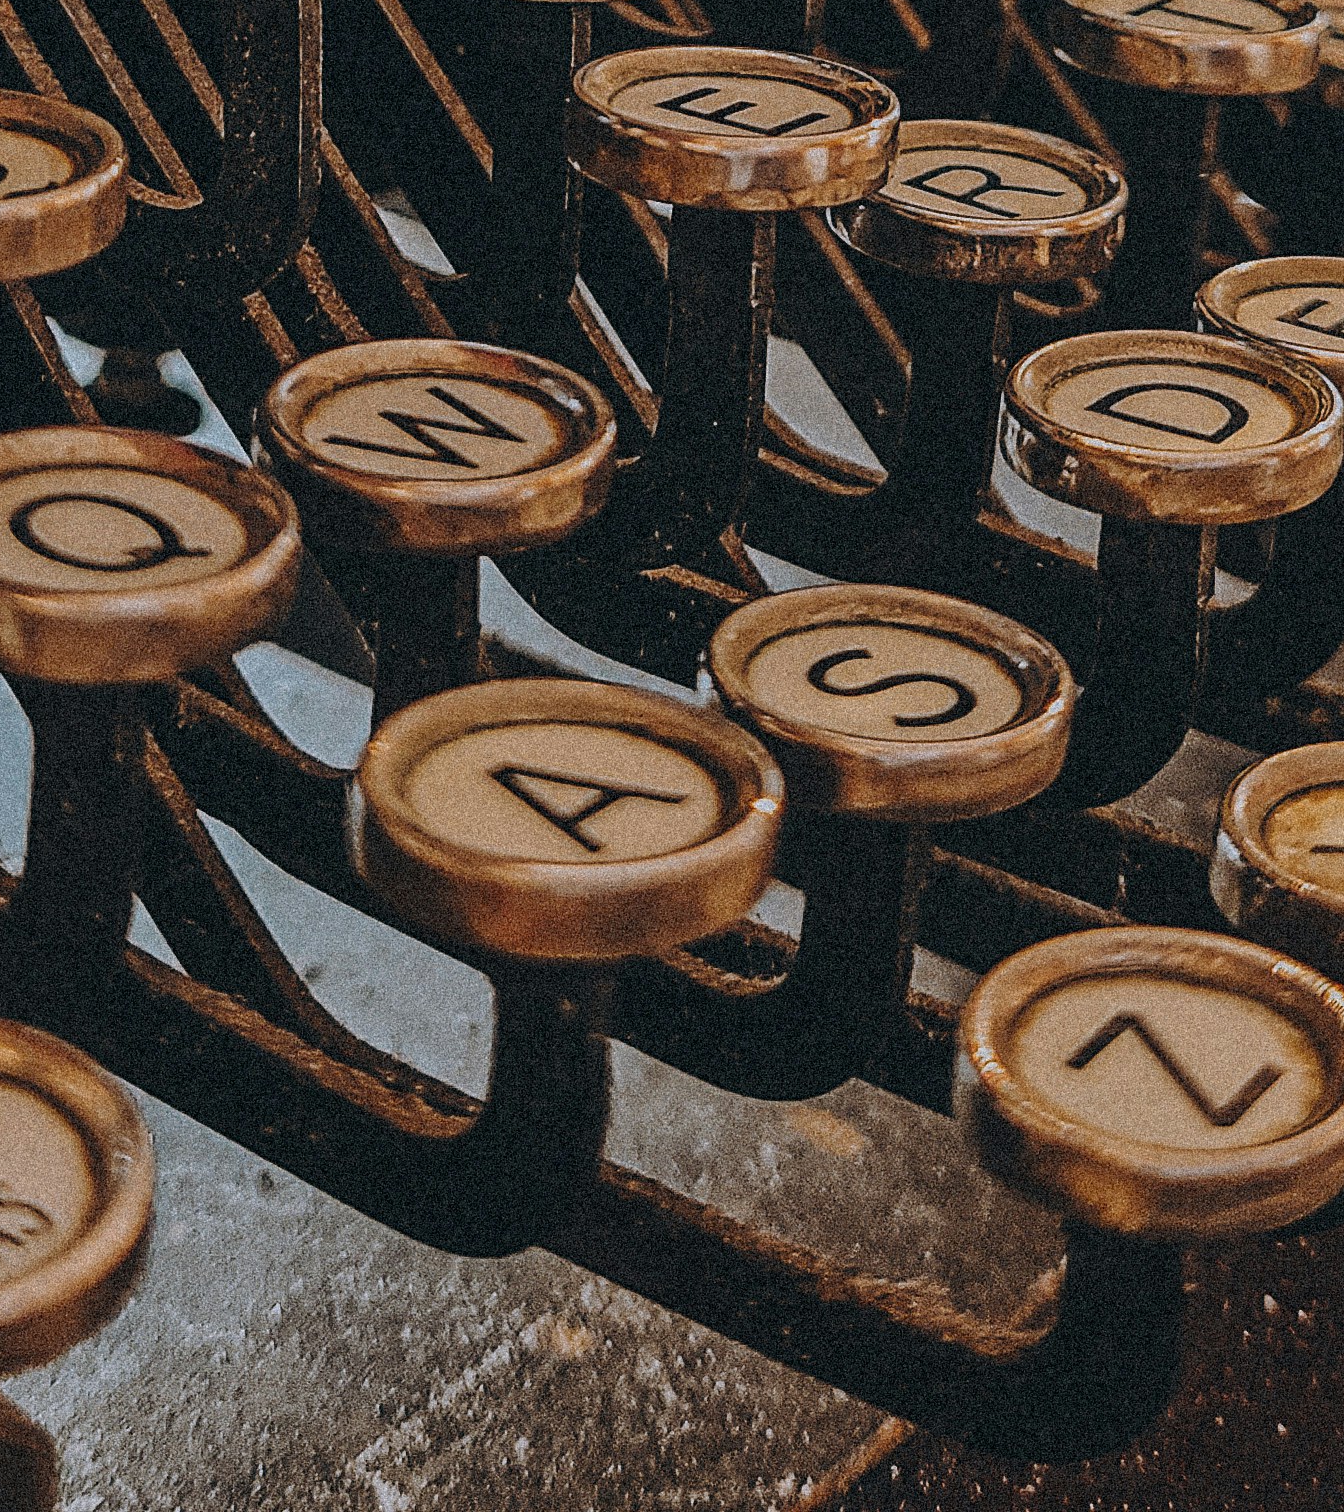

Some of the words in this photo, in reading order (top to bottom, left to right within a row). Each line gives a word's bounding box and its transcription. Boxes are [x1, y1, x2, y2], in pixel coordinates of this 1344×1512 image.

[655, 86, 832, 137] E
[899, 164, 1066, 219] R
[320, 385, 529, 470] W
[1084, 382, 1251, 445] D
[8, 492, 212, 573] Q
[807, 648, 978, 728] S
[486, 763, 690, 854] A
[1064, 1010, 1286, 1128] Z
